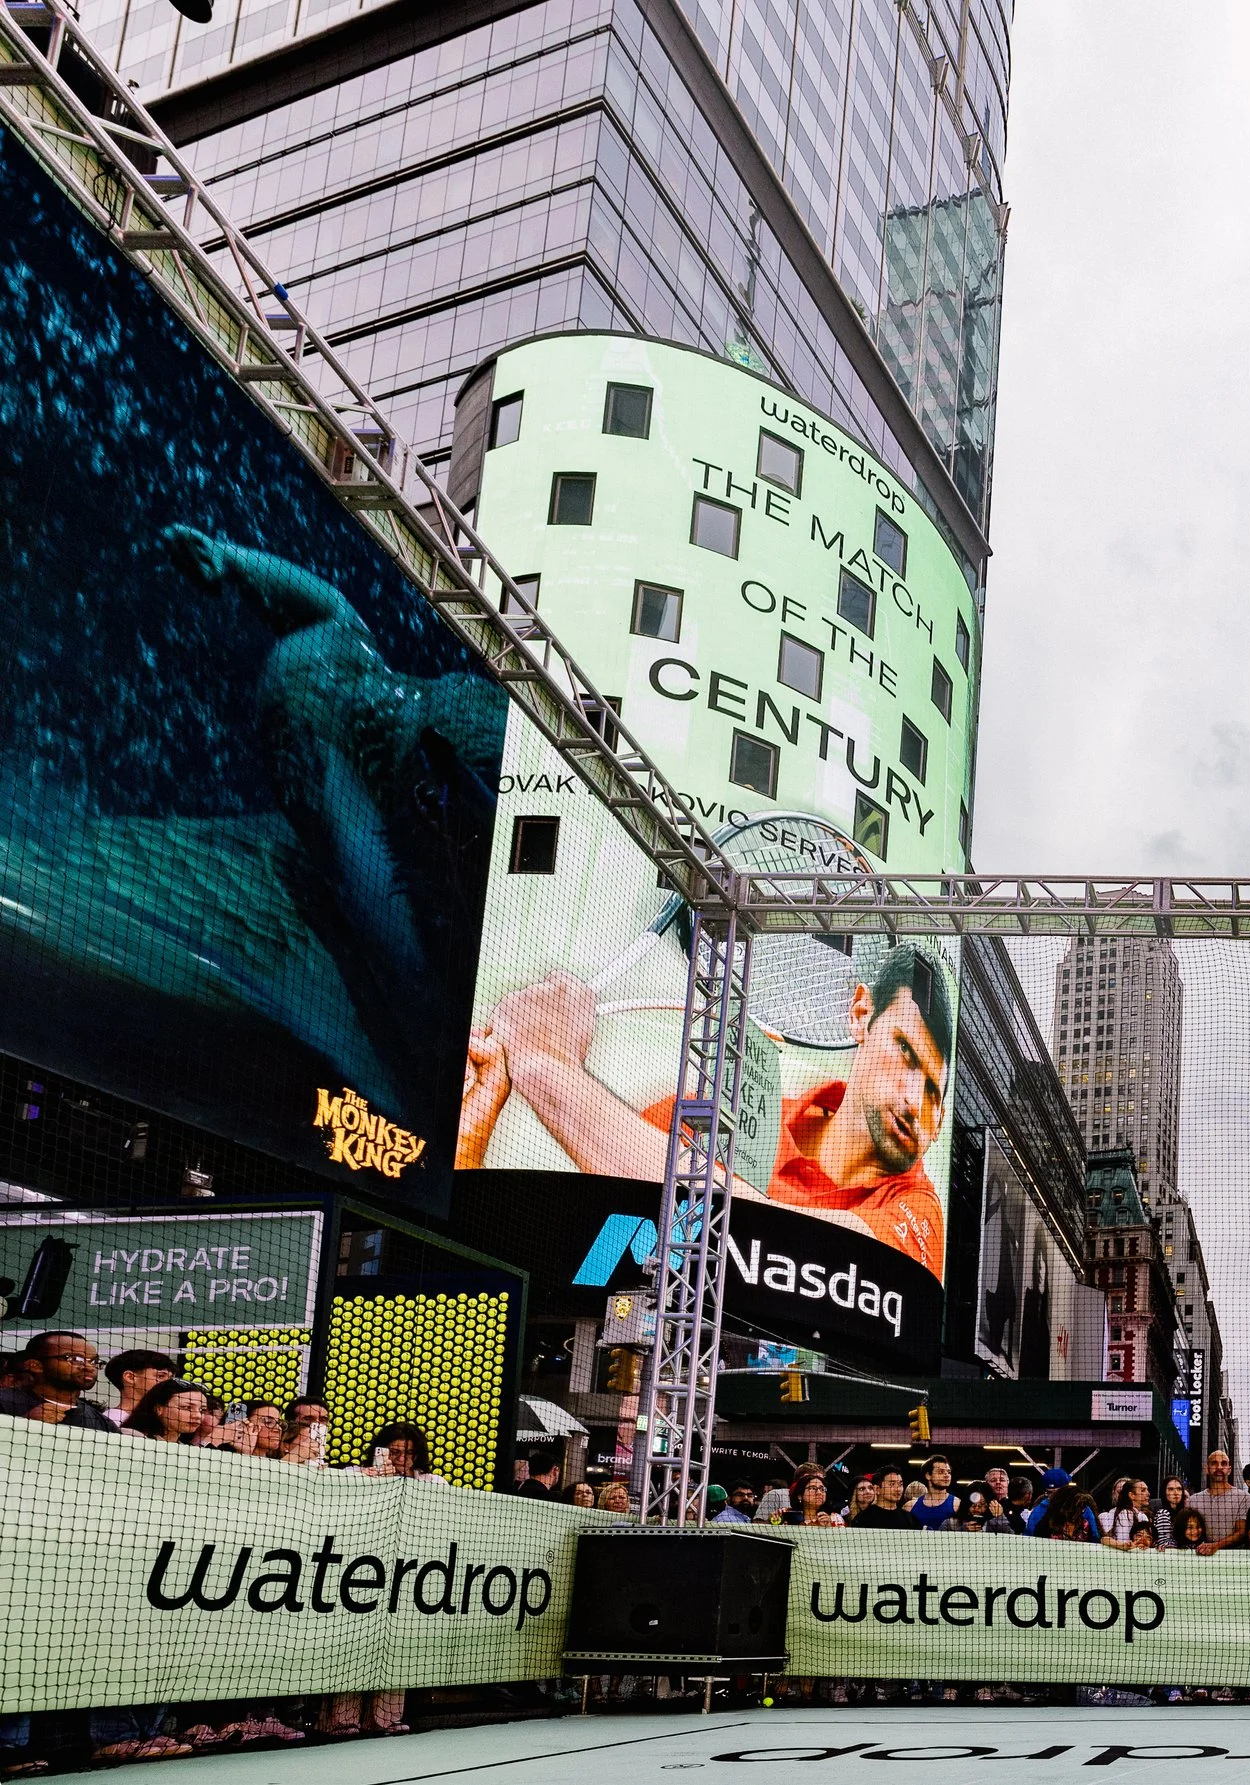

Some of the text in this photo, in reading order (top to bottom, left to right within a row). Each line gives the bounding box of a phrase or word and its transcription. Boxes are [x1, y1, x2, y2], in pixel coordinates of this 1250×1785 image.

[692, 457, 934, 645] THE MATCH
[740, 580, 898, 699] OF THE
[648, 657, 935, 837] CENTURY
[313, 1087, 427, 1163] MONKEY
[342, 1087, 368, 1112] THE
[739, 1108, 757, 1140] RO
[329, 1127, 407, 1178] KING
[93, 1246, 251, 1274] HYDRATE
[716, 1232, 903, 1338] Nasdaq
[89, 1276, 288, 1306] LIKE A PRO!
[1107, 1402, 1138, 1412] Turner
[1189, 1352, 1203, 1427] Foot Locker
[597, 1453, 633, 1465] brand
